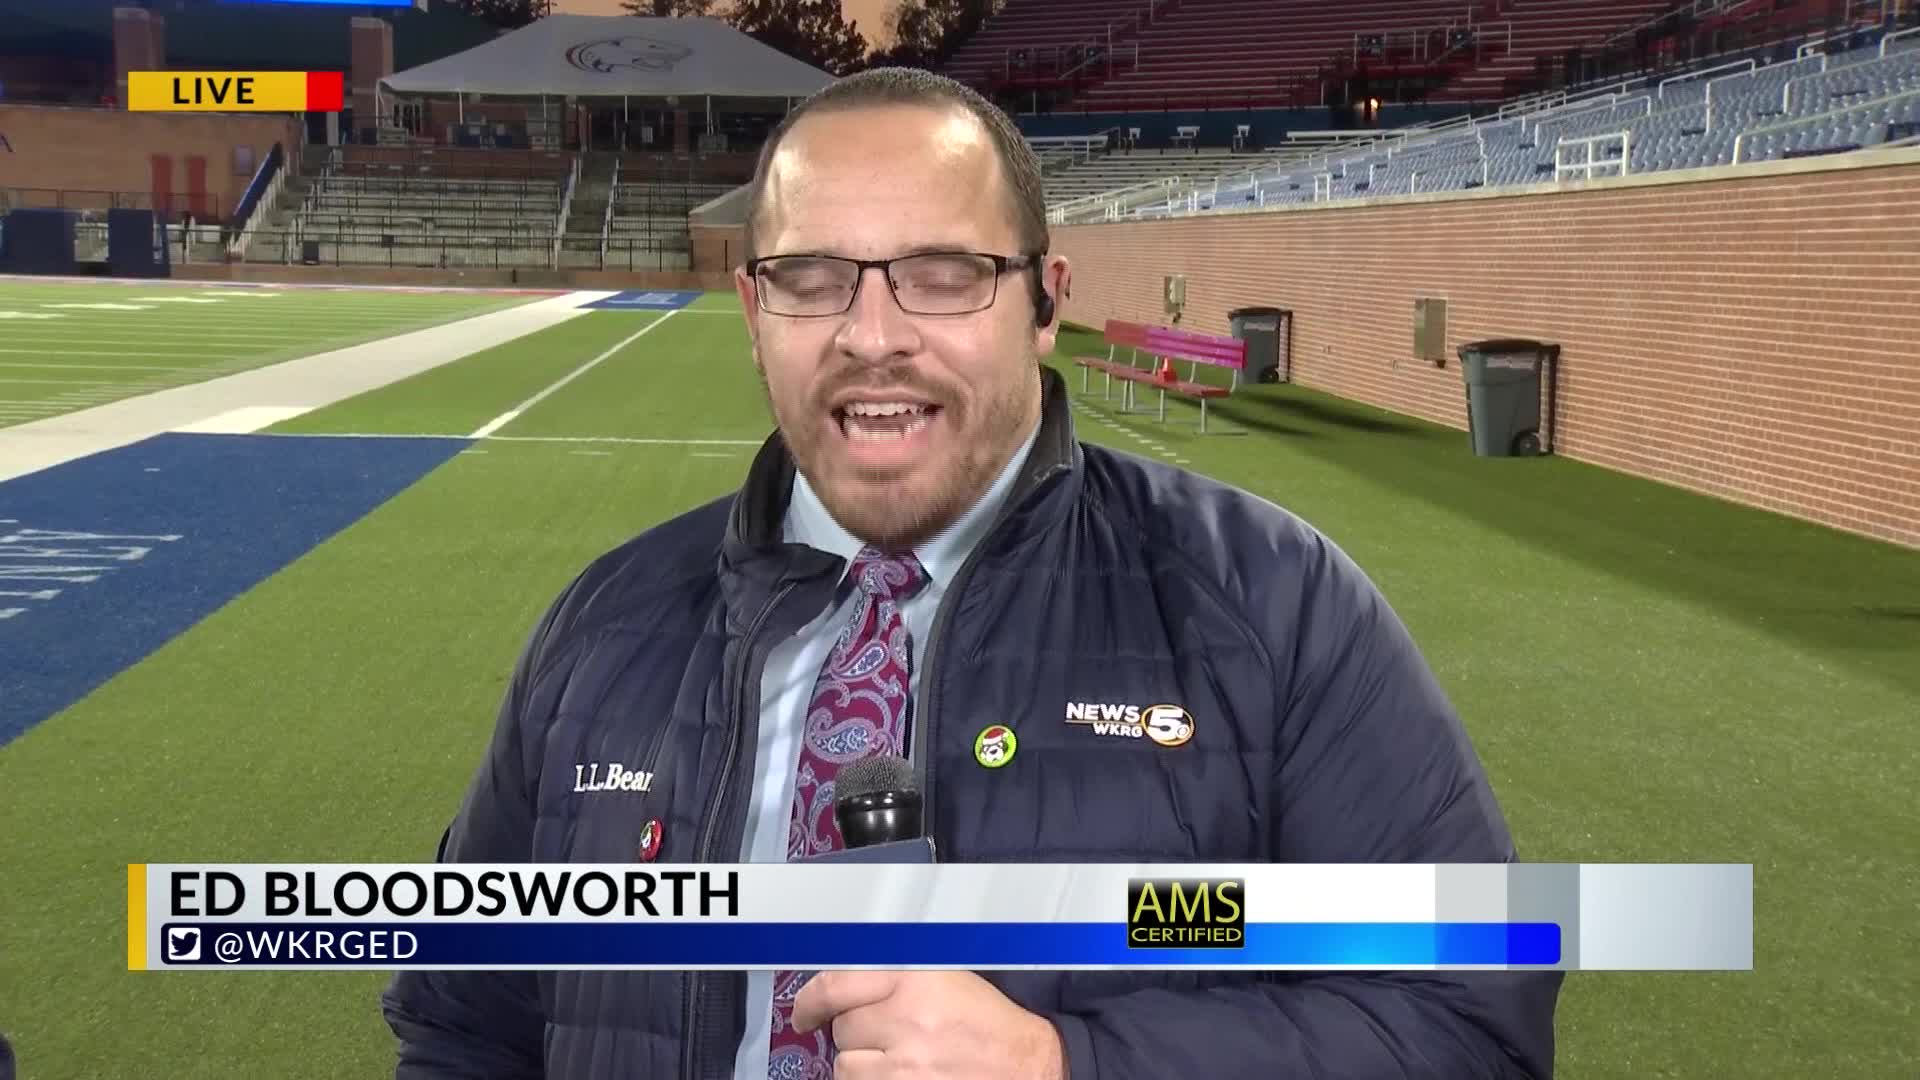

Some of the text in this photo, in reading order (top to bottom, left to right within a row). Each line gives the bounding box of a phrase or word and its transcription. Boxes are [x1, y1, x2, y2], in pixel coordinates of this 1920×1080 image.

[1065, 701, 1185, 742] NEWS 5
[1092, 721, 1143, 738] WKRG
